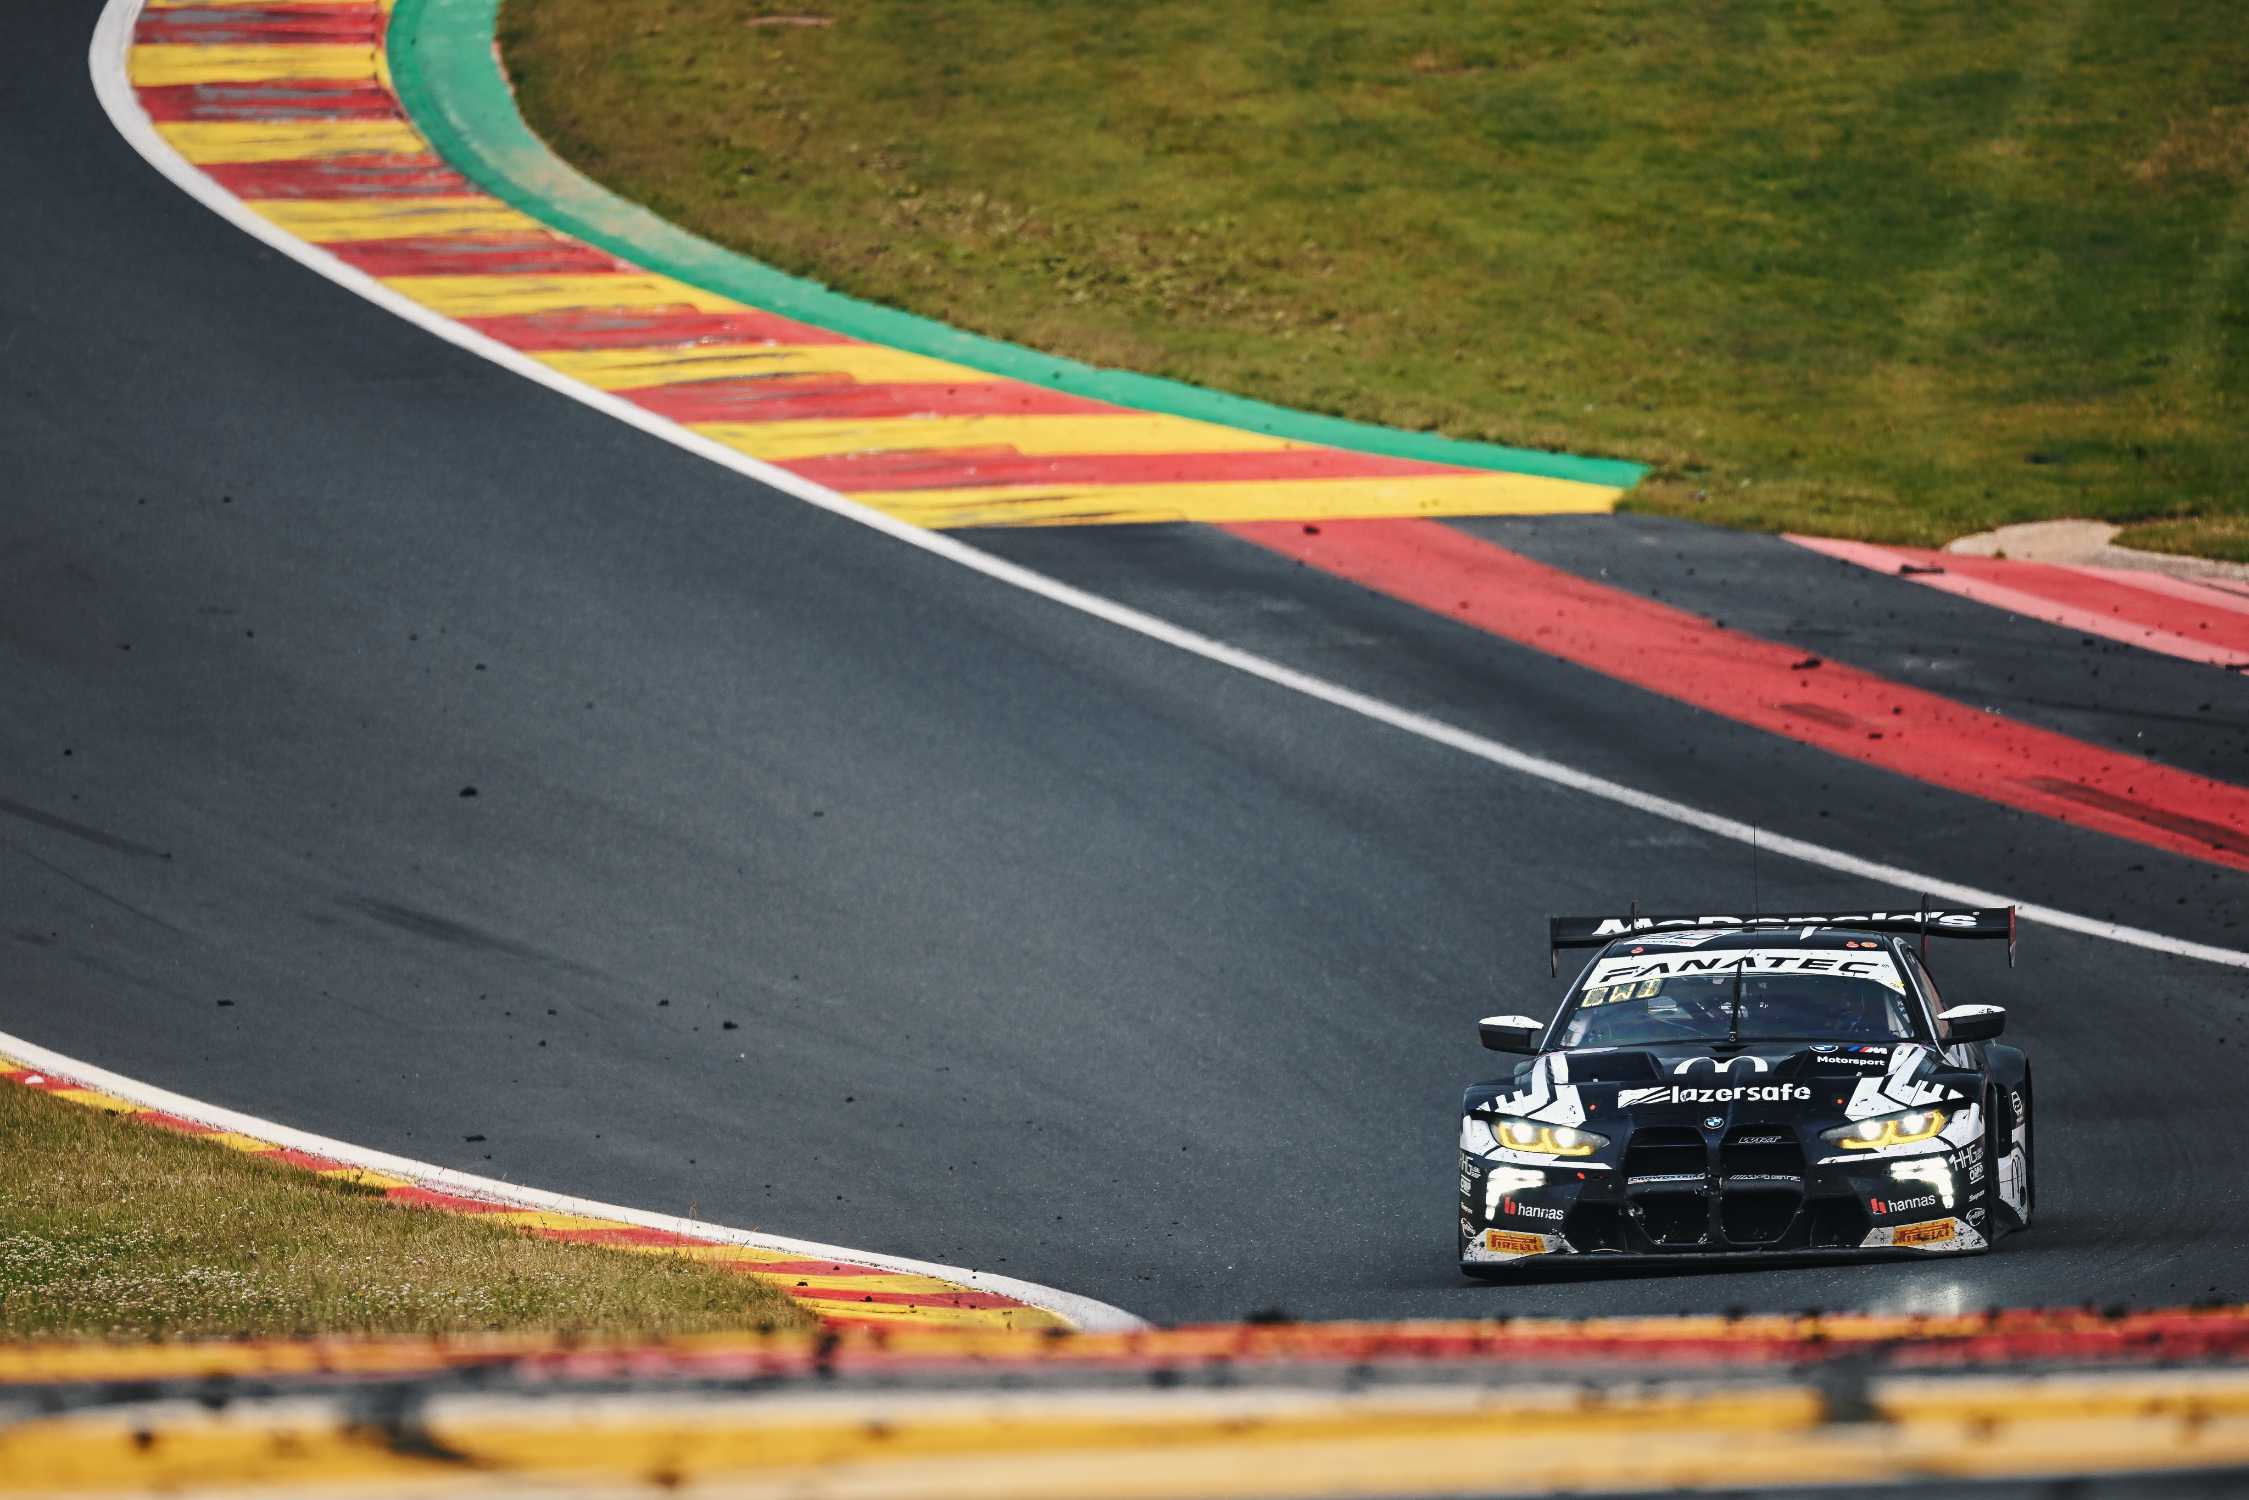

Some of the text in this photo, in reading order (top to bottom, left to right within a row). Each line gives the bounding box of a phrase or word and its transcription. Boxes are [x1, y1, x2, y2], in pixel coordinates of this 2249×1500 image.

[1599, 956, 1879, 983] FANATEC
[1816, 1055, 1886, 1067] Motorsport
[1671, 1083, 1812, 1104] lazersafe
[1517, 1202, 1565, 1220] hannas
[1887, 1194, 1936, 1213] hannas
